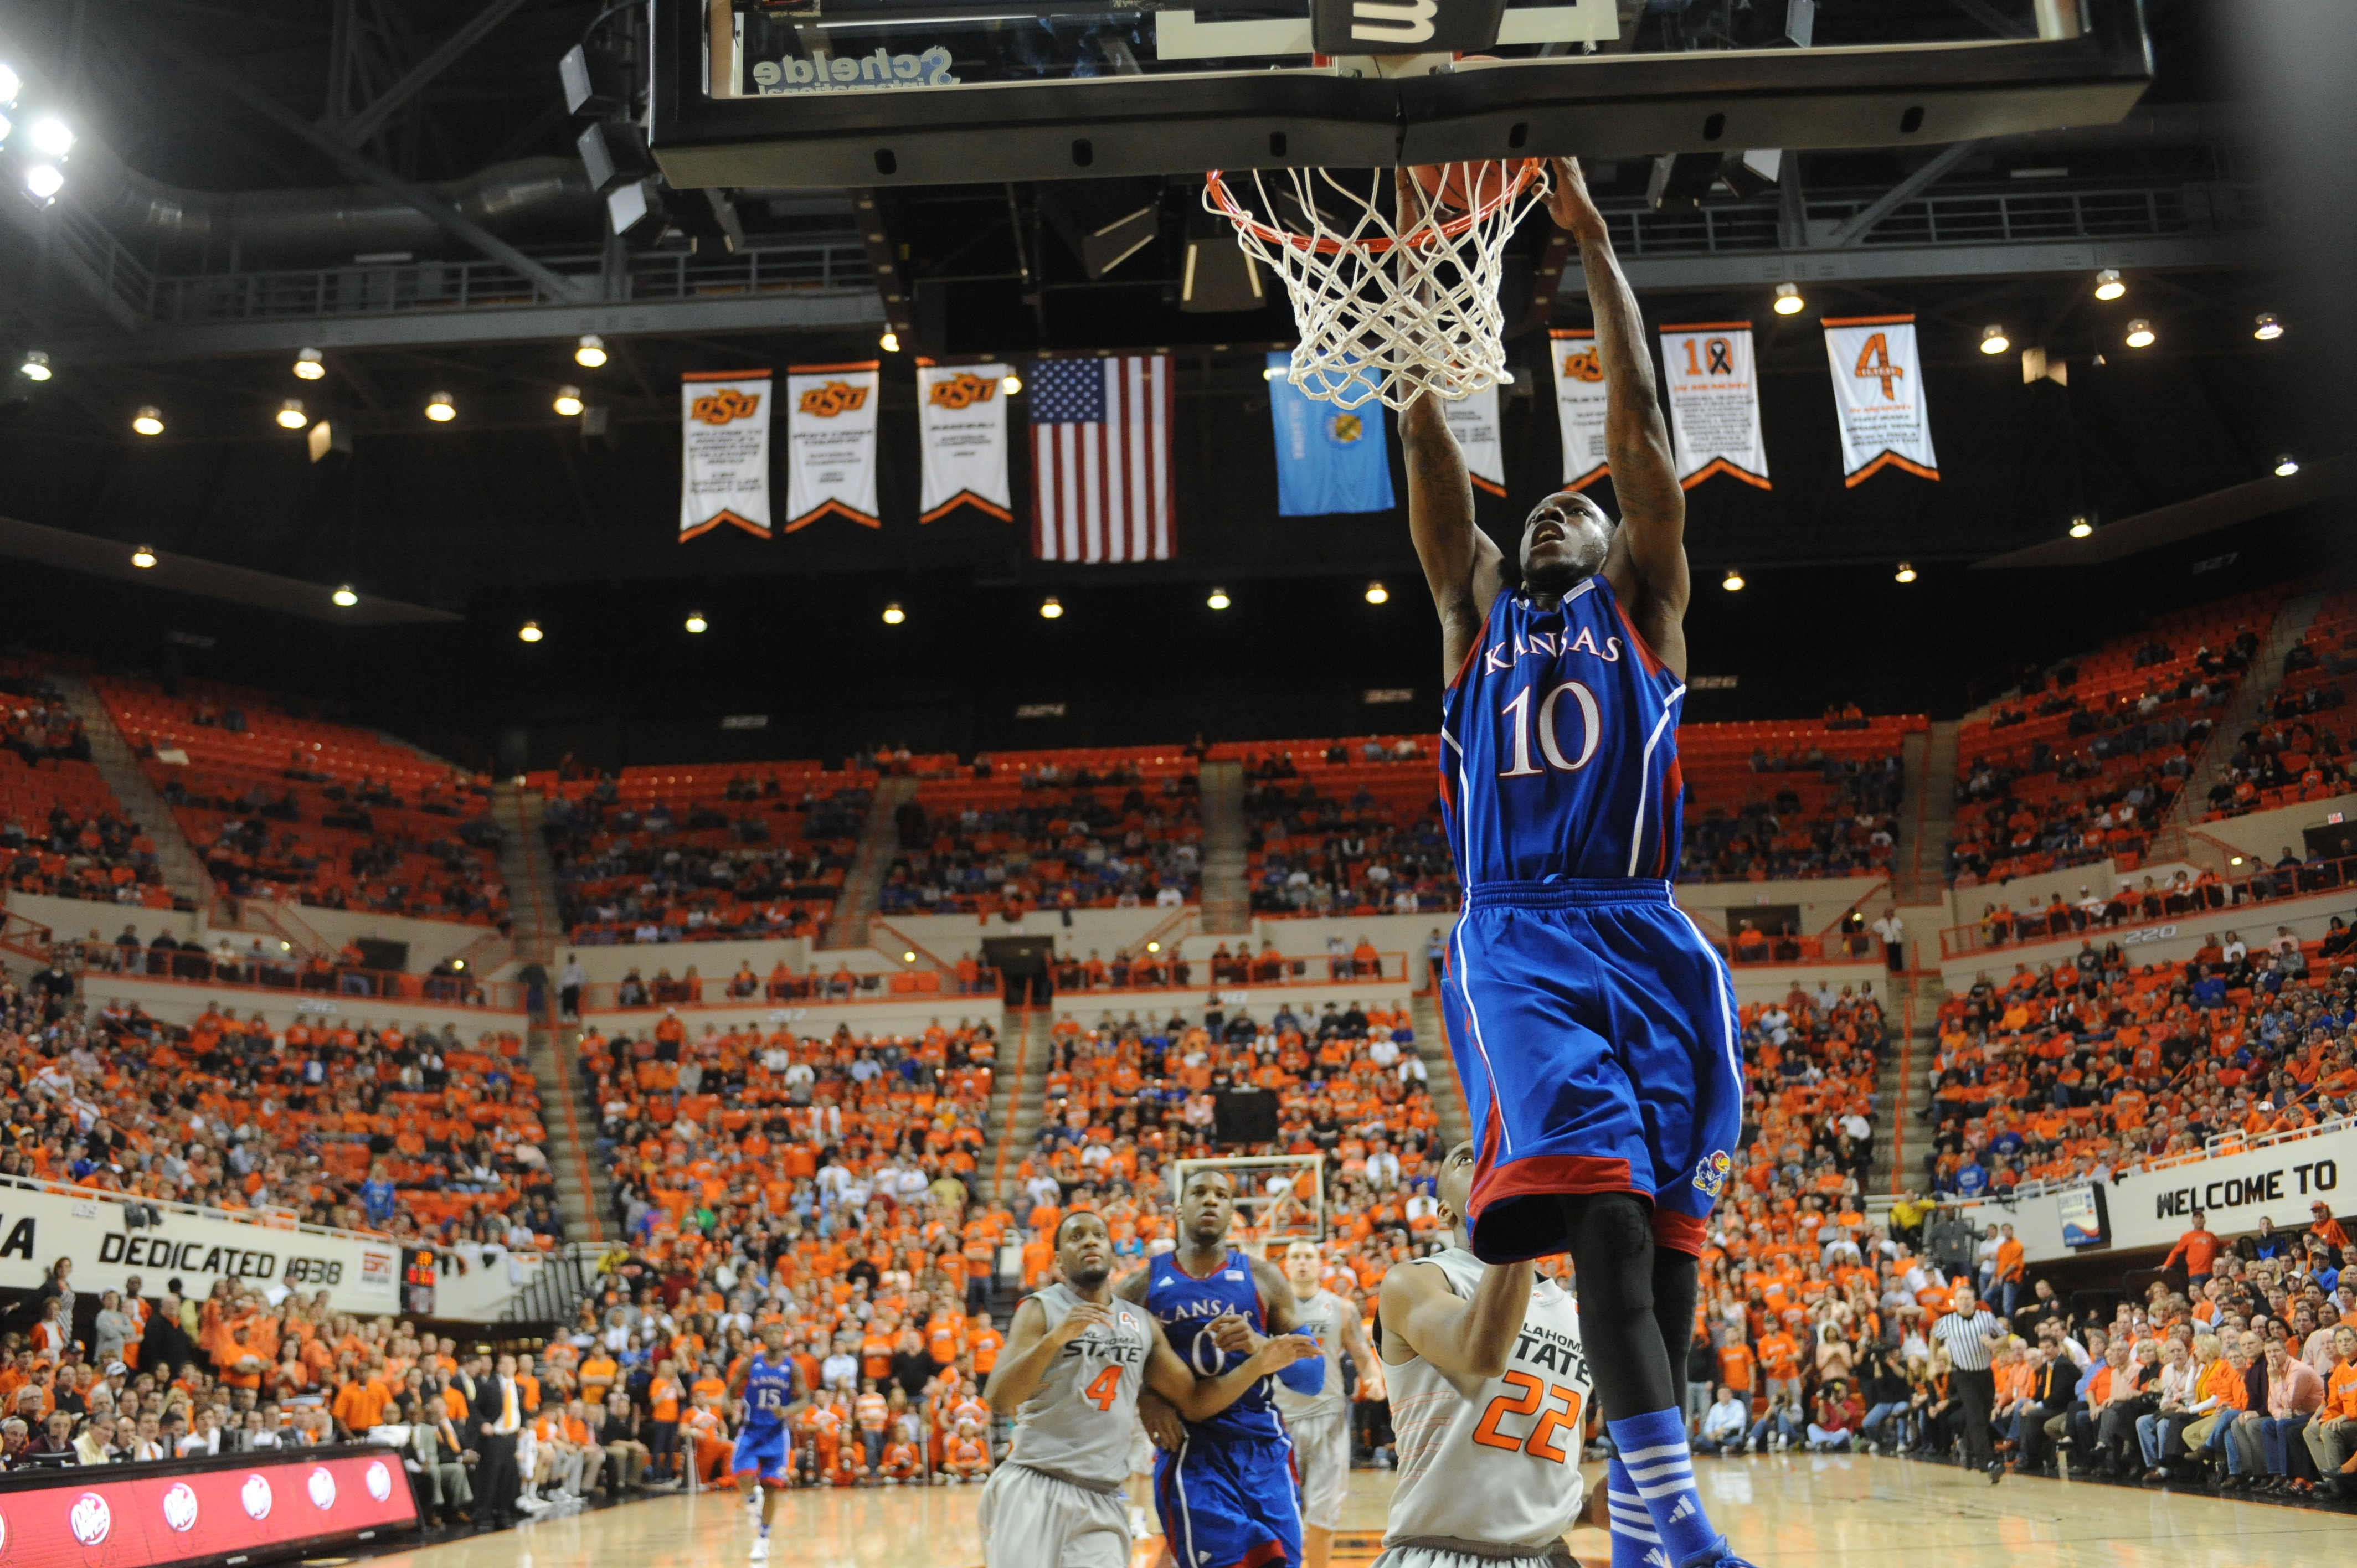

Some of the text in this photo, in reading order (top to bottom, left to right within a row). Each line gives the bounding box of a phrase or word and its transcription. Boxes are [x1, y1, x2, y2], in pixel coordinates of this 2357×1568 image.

[1564, 345, 1605, 382] OS
[1855, 333, 1903, 400] 4
[691, 389, 761, 425] OSU
[799, 381, 870, 417] OSU
[929, 373, 999, 410] OSU
[1485, 626, 1622, 677] KANSAS
[1499, 681, 1601, 777] 10
[2124, 925, 2178, 945] 220
[2157, 1159, 2337, 1219] WELCOME TO
[0, 1213, 36, 1261] A
[99, 1232, 275, 1280] DEDICATED
[1517, 1334, 1590, 1387] TATE
[1523, 1322, 1582, 1353] LAHOM
[757, 1389, 781, 1410] 15
[1085, 1365, 1124, 1411] 4
[1473, 1369, 1581, 1464] 22
